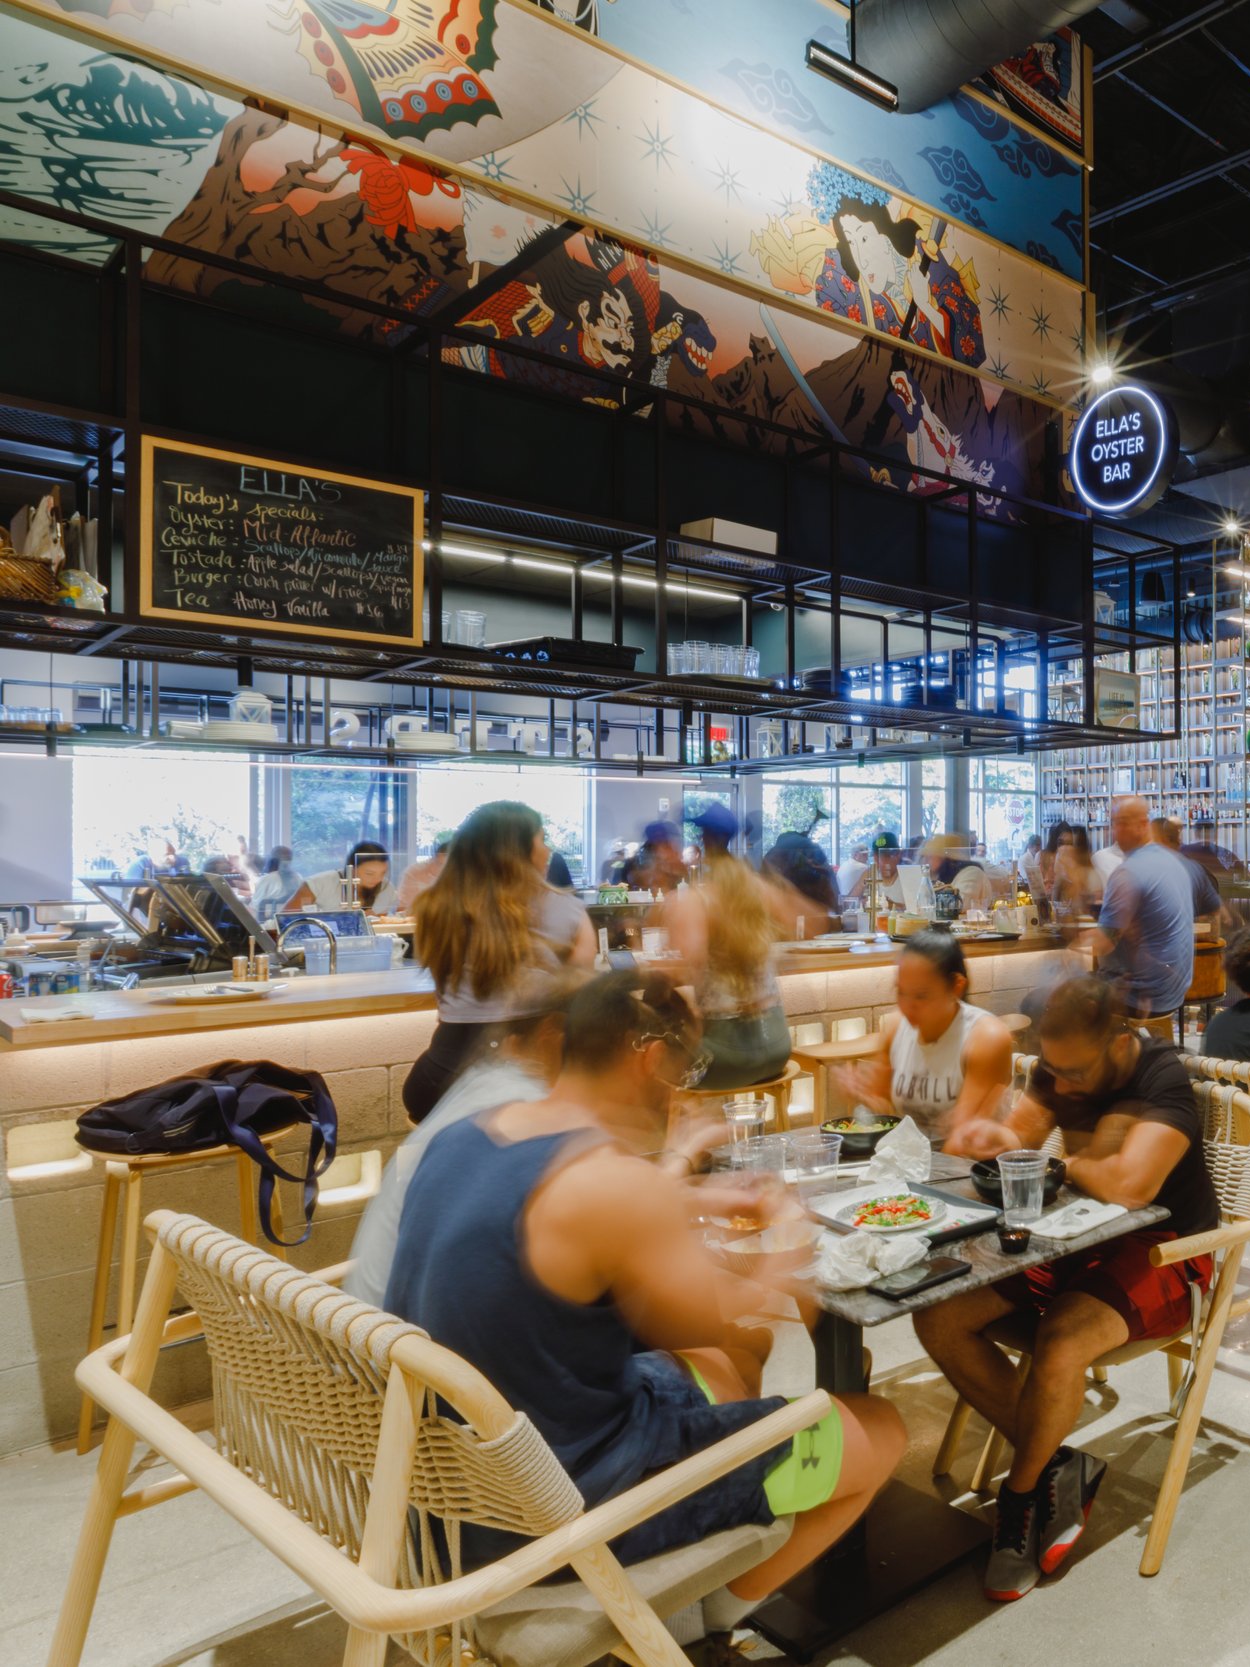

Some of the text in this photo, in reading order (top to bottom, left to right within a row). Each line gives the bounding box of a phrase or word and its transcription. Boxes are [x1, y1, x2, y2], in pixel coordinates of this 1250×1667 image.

[1096, 412, 1141, 438] ELLA'S
[1091, 435, 1144, 462] OYSTER
[240, 465, 342, 503] ELLA'S
[1103, 462, 1131, 483] BAR
[162, 480, 239, 515] Today's
[163, 588, 330, 619] Tea Honey Vanilla
[1008, 807, 1025, 818] STOP
